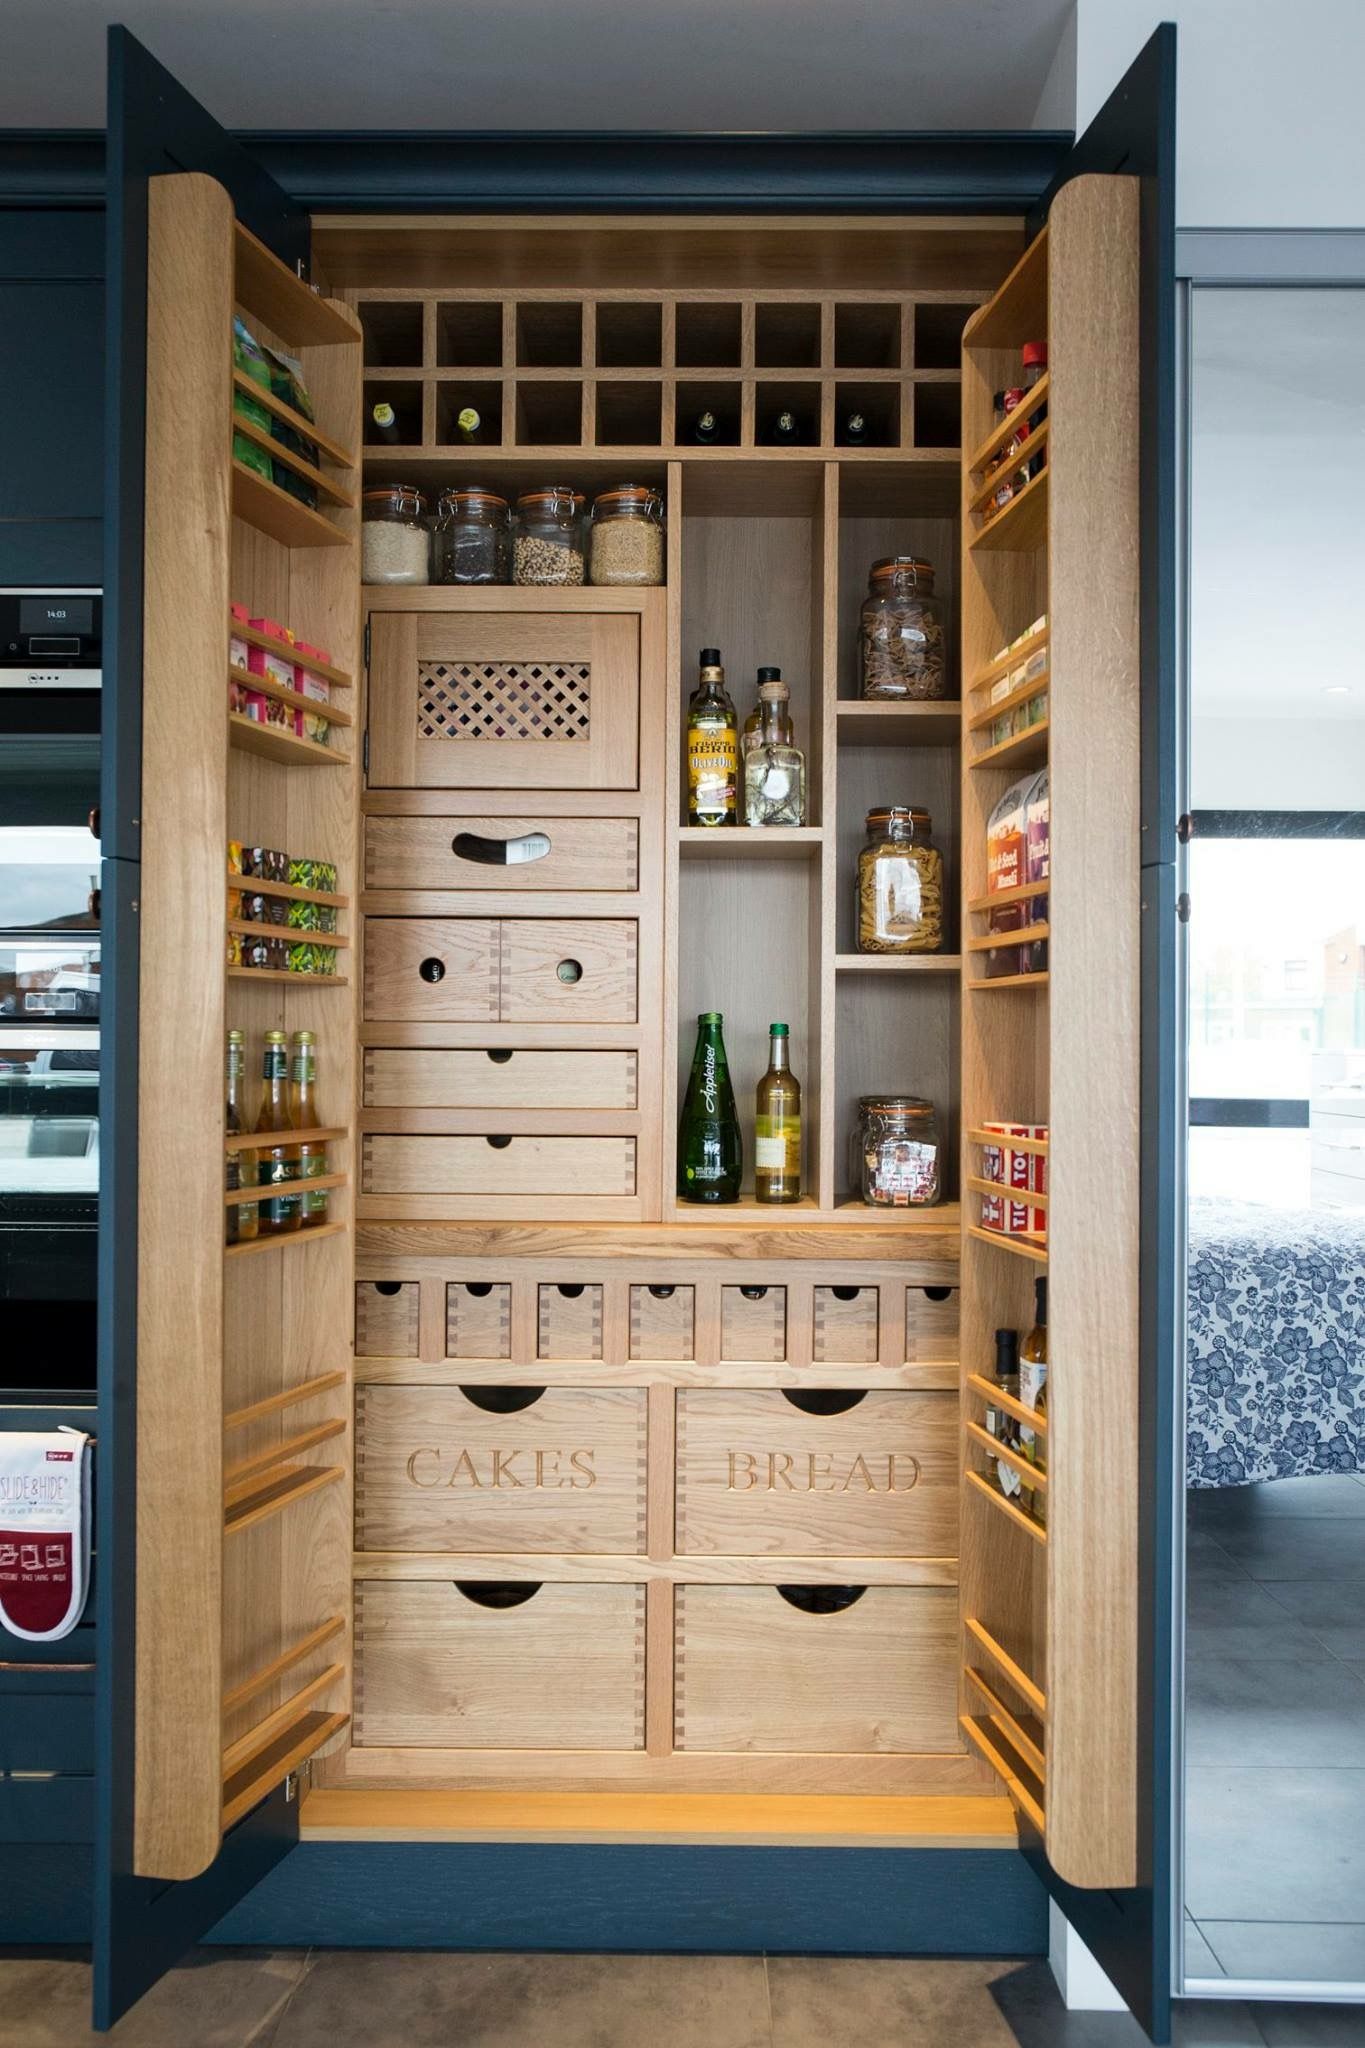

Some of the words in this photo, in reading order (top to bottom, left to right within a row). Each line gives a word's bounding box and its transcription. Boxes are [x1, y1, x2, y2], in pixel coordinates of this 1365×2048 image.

[690, 745, 736, 754] BERIO
[701, 1043, 718, 1114] Appletiser
[406, 1447, 598, 1490] CAKES
[726, 1451, 923, 1493] BREAD
